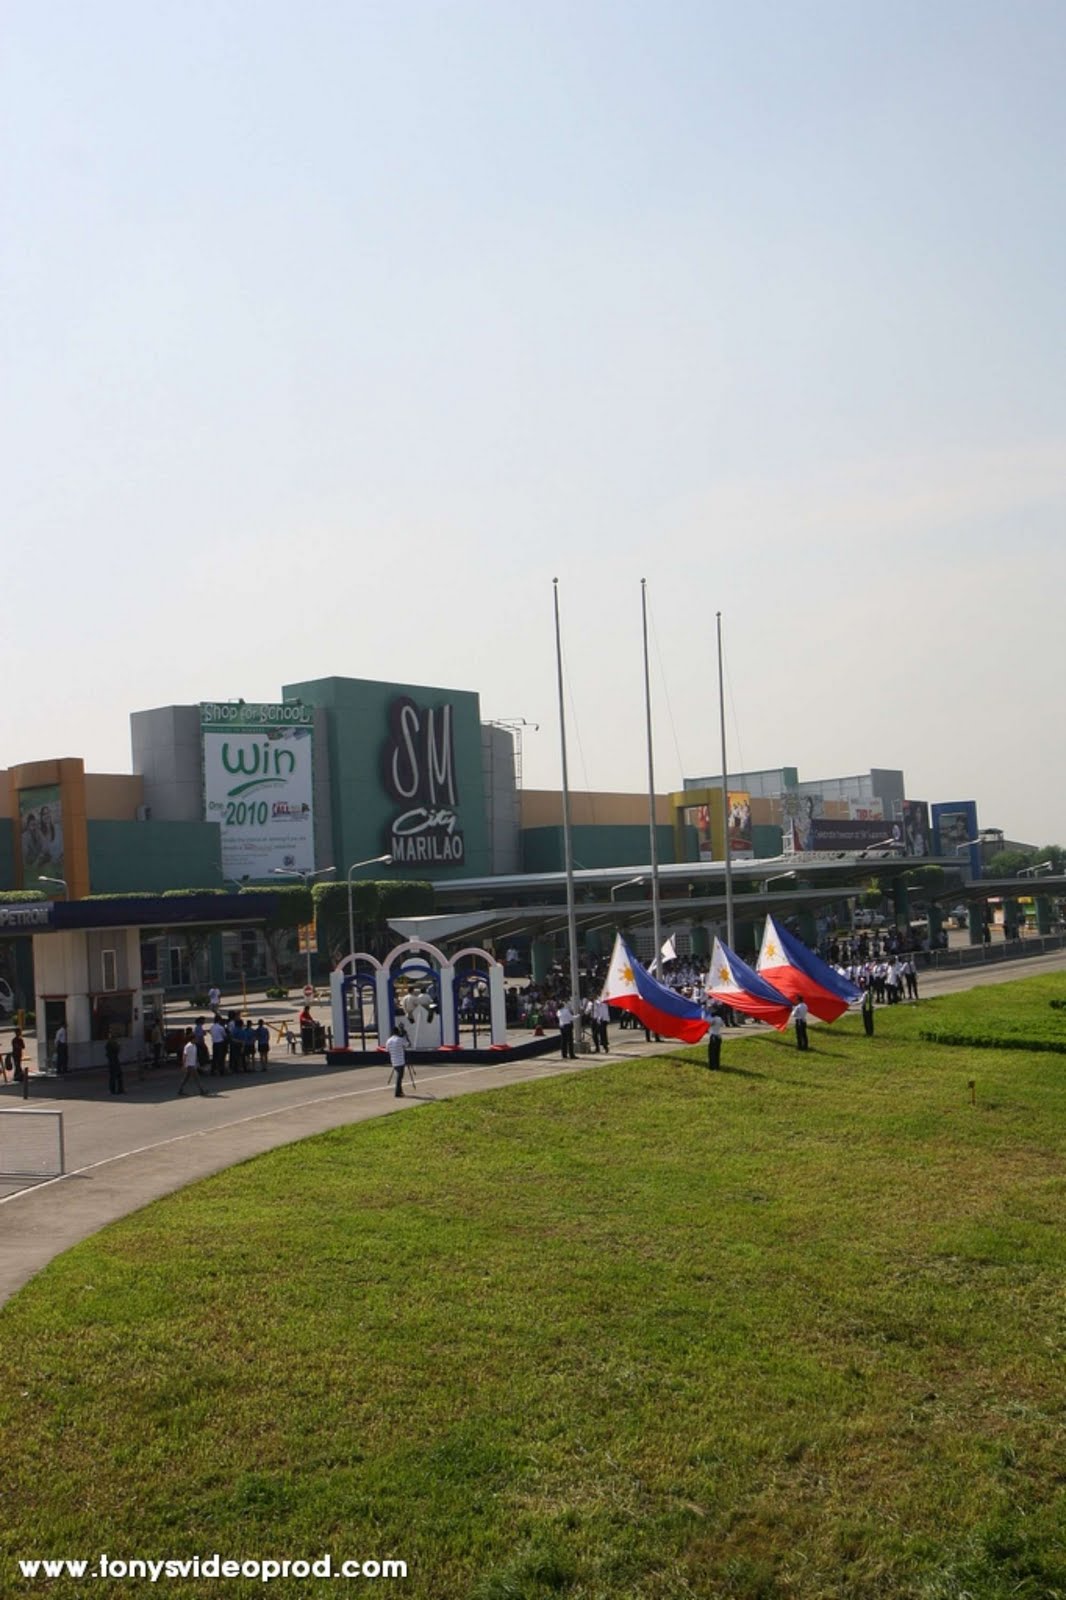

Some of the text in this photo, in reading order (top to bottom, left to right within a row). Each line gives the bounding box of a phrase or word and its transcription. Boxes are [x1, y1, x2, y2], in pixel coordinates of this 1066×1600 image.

[204, 704, 237, 721] Shop
[391, 704, 456, 806] SM
[225, 801, 268, 826] 2010
[392, 807, 456, 834] City
[391, 836, 463, 862] MARILAO
[0, 908, 49, 927] PETRON
